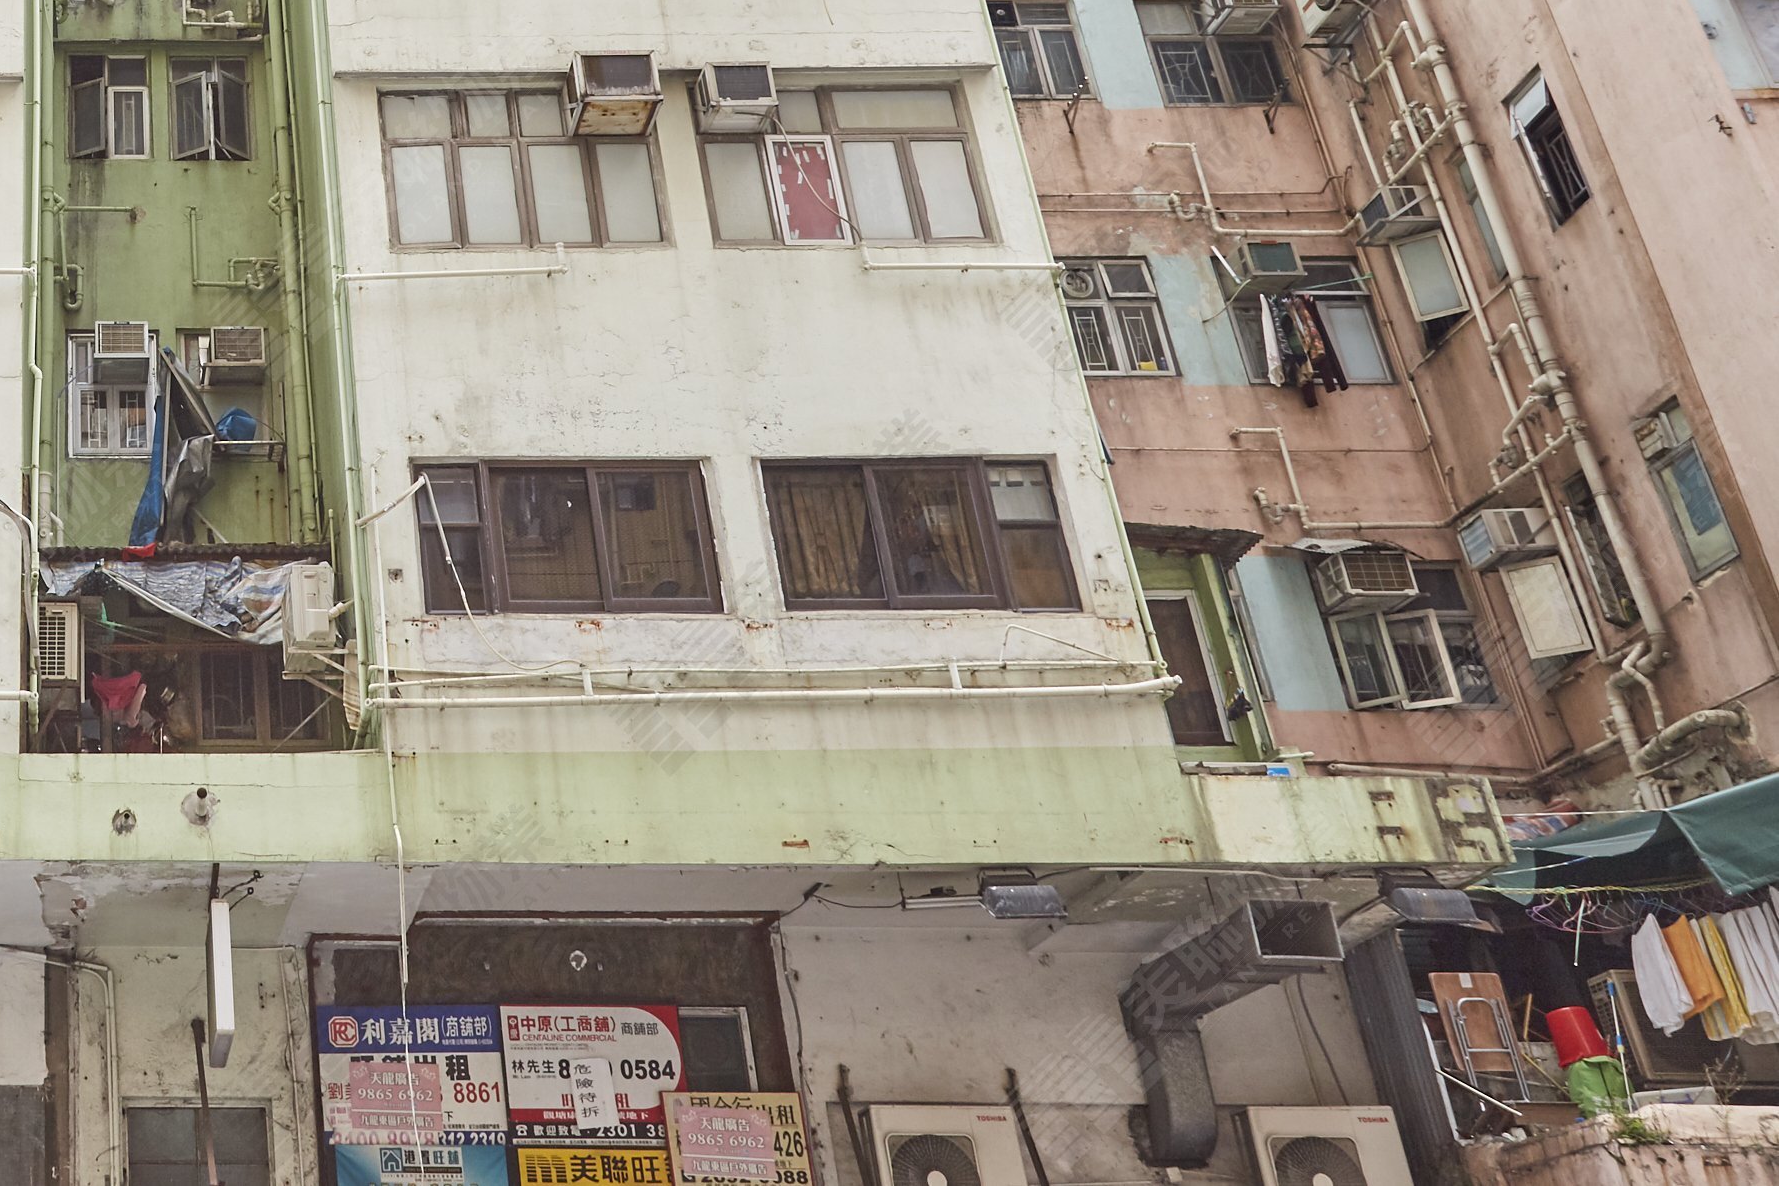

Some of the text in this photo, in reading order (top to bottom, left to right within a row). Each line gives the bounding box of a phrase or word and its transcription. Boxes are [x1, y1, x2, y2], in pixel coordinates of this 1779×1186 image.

[522, 1034, 617, 1043] CENTALINE COMMERCIAL
[511, 1059, 556, 1074] 林先生
[620, 1059, 676, 1080] 0584
[358, 1089, 393, 1100] 9865
[453, 1082, 501, 1103] 8861
[688, 1133, 765, 1149] 9865 6962
[569, 1154, 677, 1184] 美聯旺
